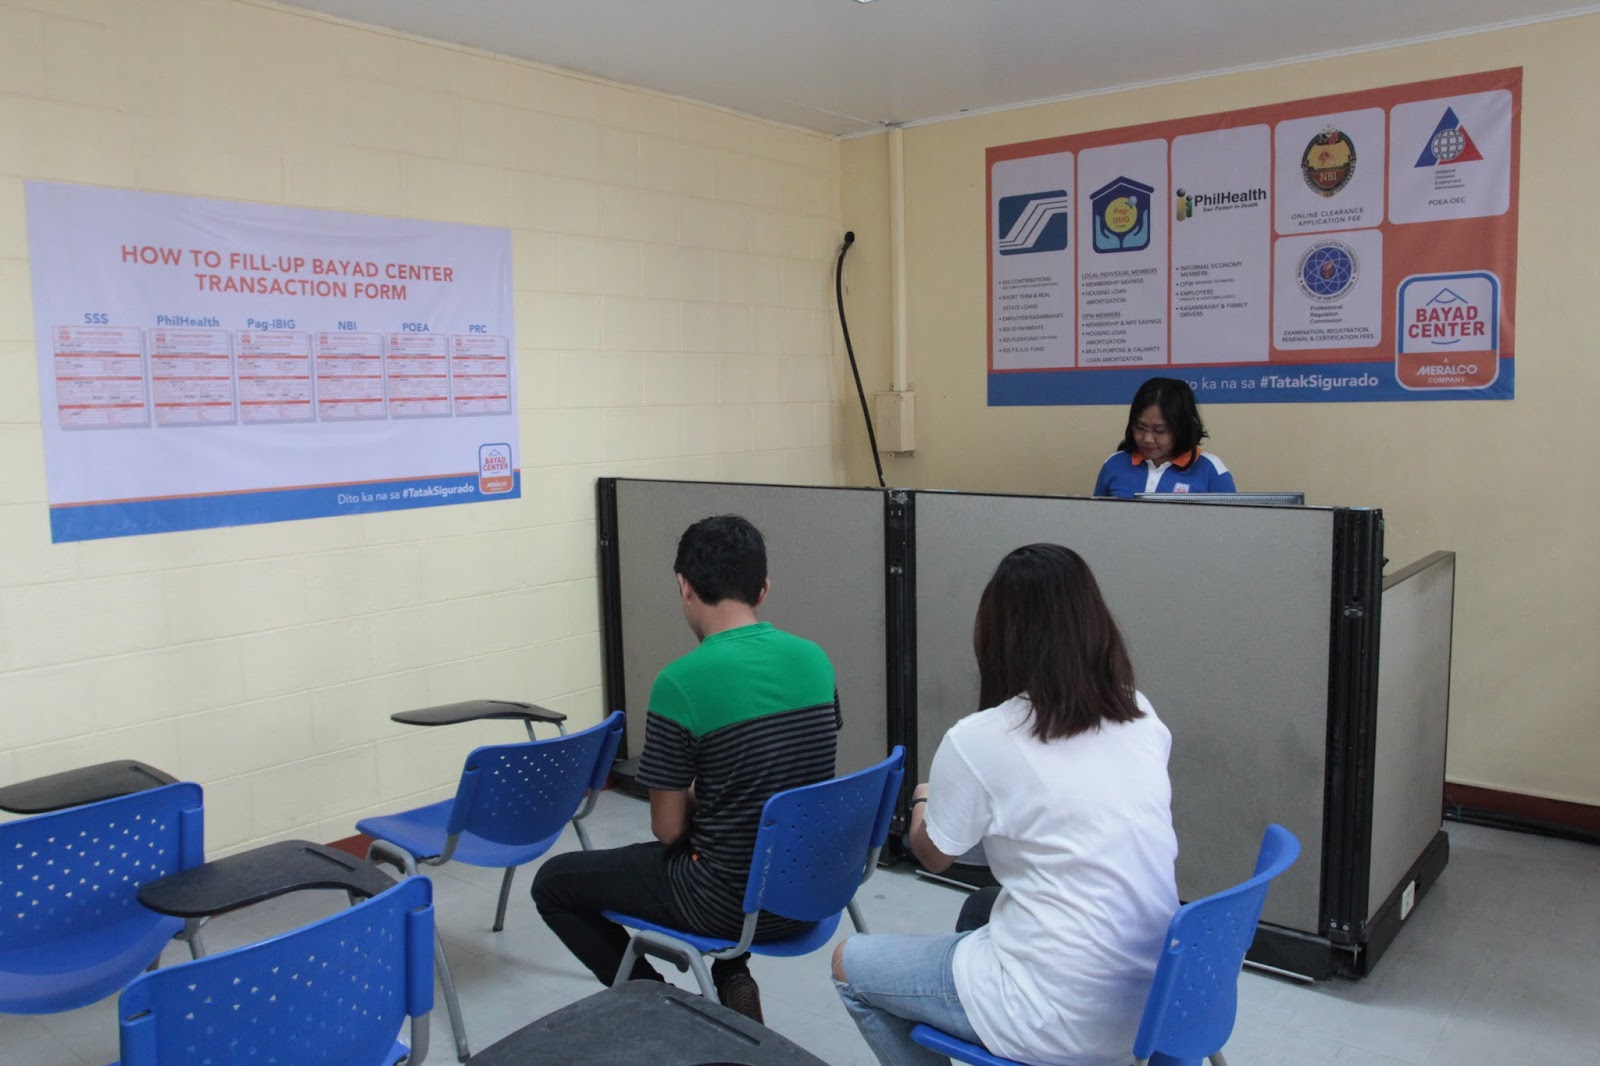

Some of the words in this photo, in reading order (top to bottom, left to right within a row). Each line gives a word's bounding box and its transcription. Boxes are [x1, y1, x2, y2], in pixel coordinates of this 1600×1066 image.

[1320, 171, 1337, 182] NBI
[1194, 188, 1267, 207] PhilHealth
[1291, 211, 1319, 220] ONLINE
[1320, 206, 1364, 217] CLEARANCE
[1297, 217, 1345, 227] APPLICATION
[121, 244, 182, 266] HOW
[190, 249, 222, 268] TO
[229, 252, 305, 273] FILL-UP
[312, 258, 379, 278] BAYAD
[385, 263, 453, 282] CENTER
[1180, 263, 1210, 271] INFORMAL
[1211, 261, 1243, 269] ECONOMY
[1131, 267, 1157, 275] MEMBERS
[1180, 270, 1208, 278] MEMBERS
[194, 273, 347, 298] TRANSACTION
[354, 283, 407, 300] FORM
[1180, 289, 1214, 297] EMPLOYERS
[1086, 297, 1127, 305] AMORTIZATION
[1180, 303, 1220, 311] KASAMBAHAY
[84, 313, 109, 324] SSS
[1415, 306, 1478, 323] BAYAD
[156, 315, 220, 327] PhilHealth
[338, 321, 357, 331] NBI
[1085, 320, 1120, 328] MEMBERSHIP
[402, 322, 430, 332] POEA
[469, 324, 487, 333] PRC
[1408, 321, 1485, 338] CENTER
[1416, 364, 1478, 376] MERALCO
[1202, 376, 1217, 389] ka
[1221, 379, 1237, 389] na
[1241, 379, 1256, 389] sa
[1260, 373, 1379, 391] #TatakSigurado
[485, 456, 506, 464] BAYAD
[483, 463, 508, 471] CENTER
[337, 493, 359, 504] Dito
[361, 492, 373, 502] ka
[376, 493, 388, 501] na
[402, 483, 475, 498] #TatakSigurado
